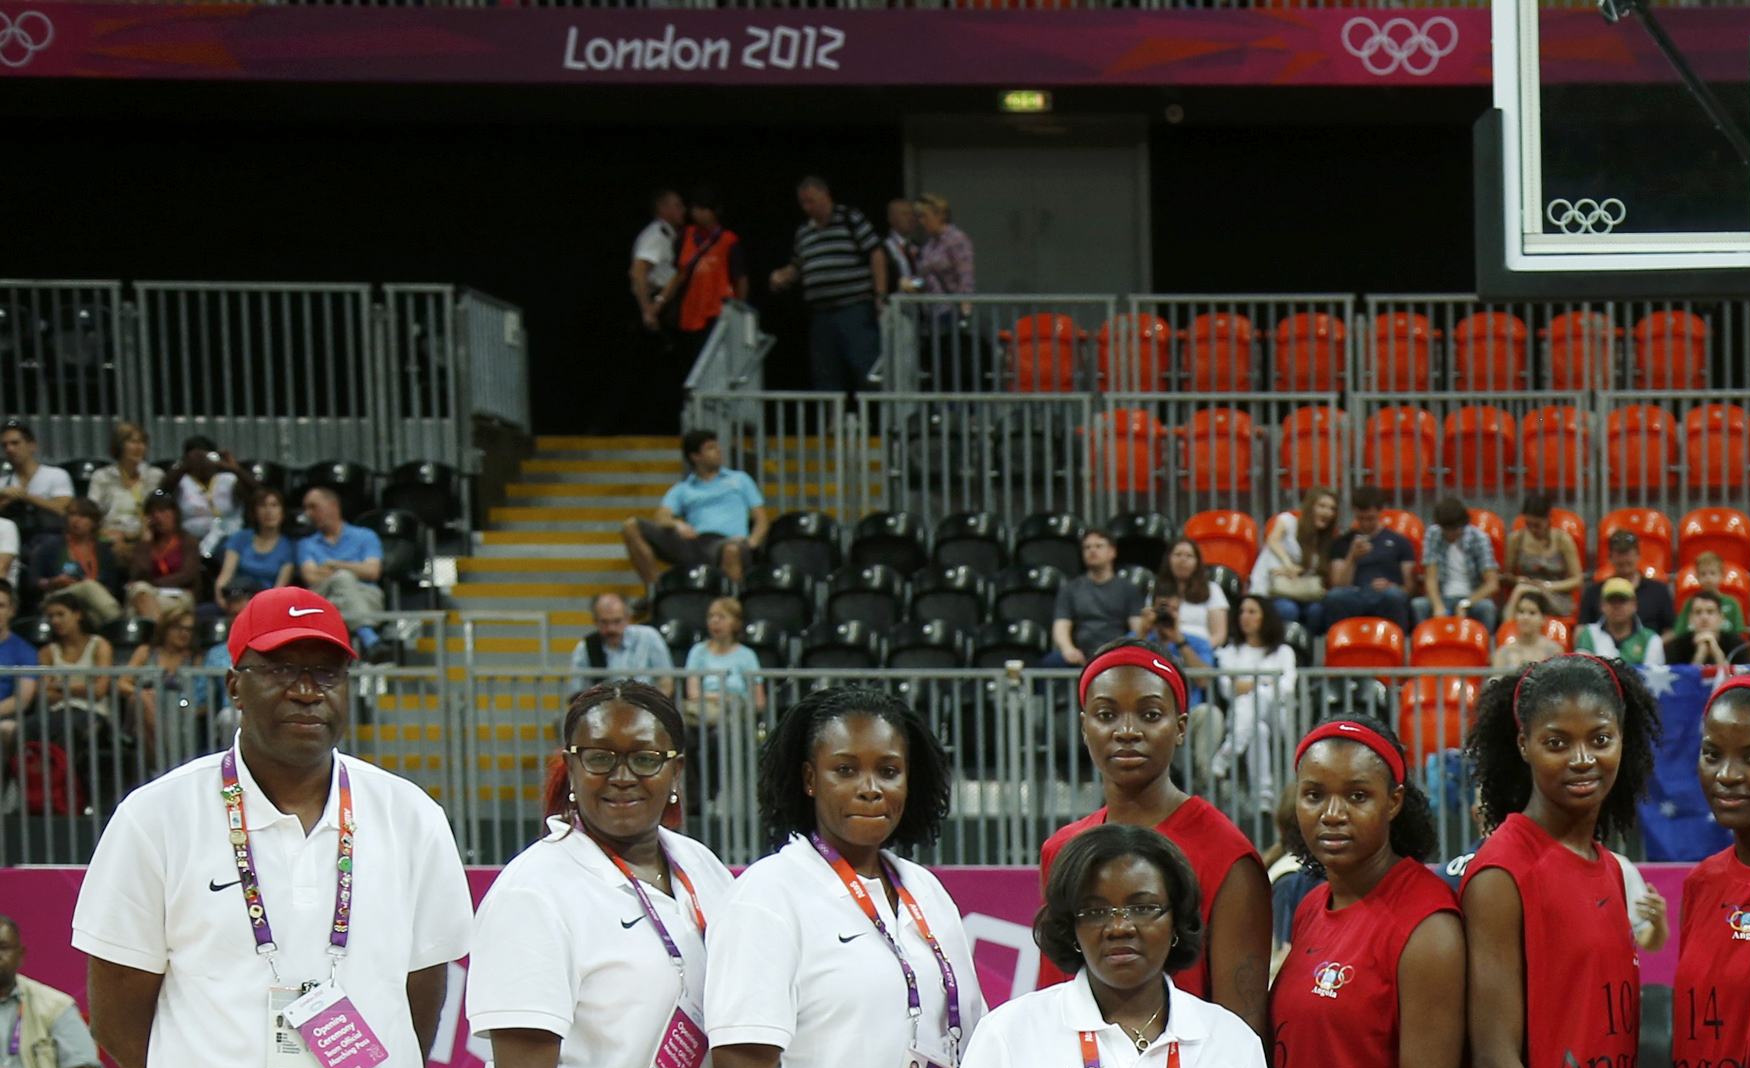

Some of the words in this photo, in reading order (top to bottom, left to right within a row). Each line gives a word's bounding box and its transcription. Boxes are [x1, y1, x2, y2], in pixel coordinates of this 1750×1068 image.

[563, 23, 731, 71] London
[740, 25, 846, 71] 2012
[1311, 986, 1338, 999] Angola
[1602, 979, 1633, 1037] 10
[1687, 985, 1724, 1041] 14
